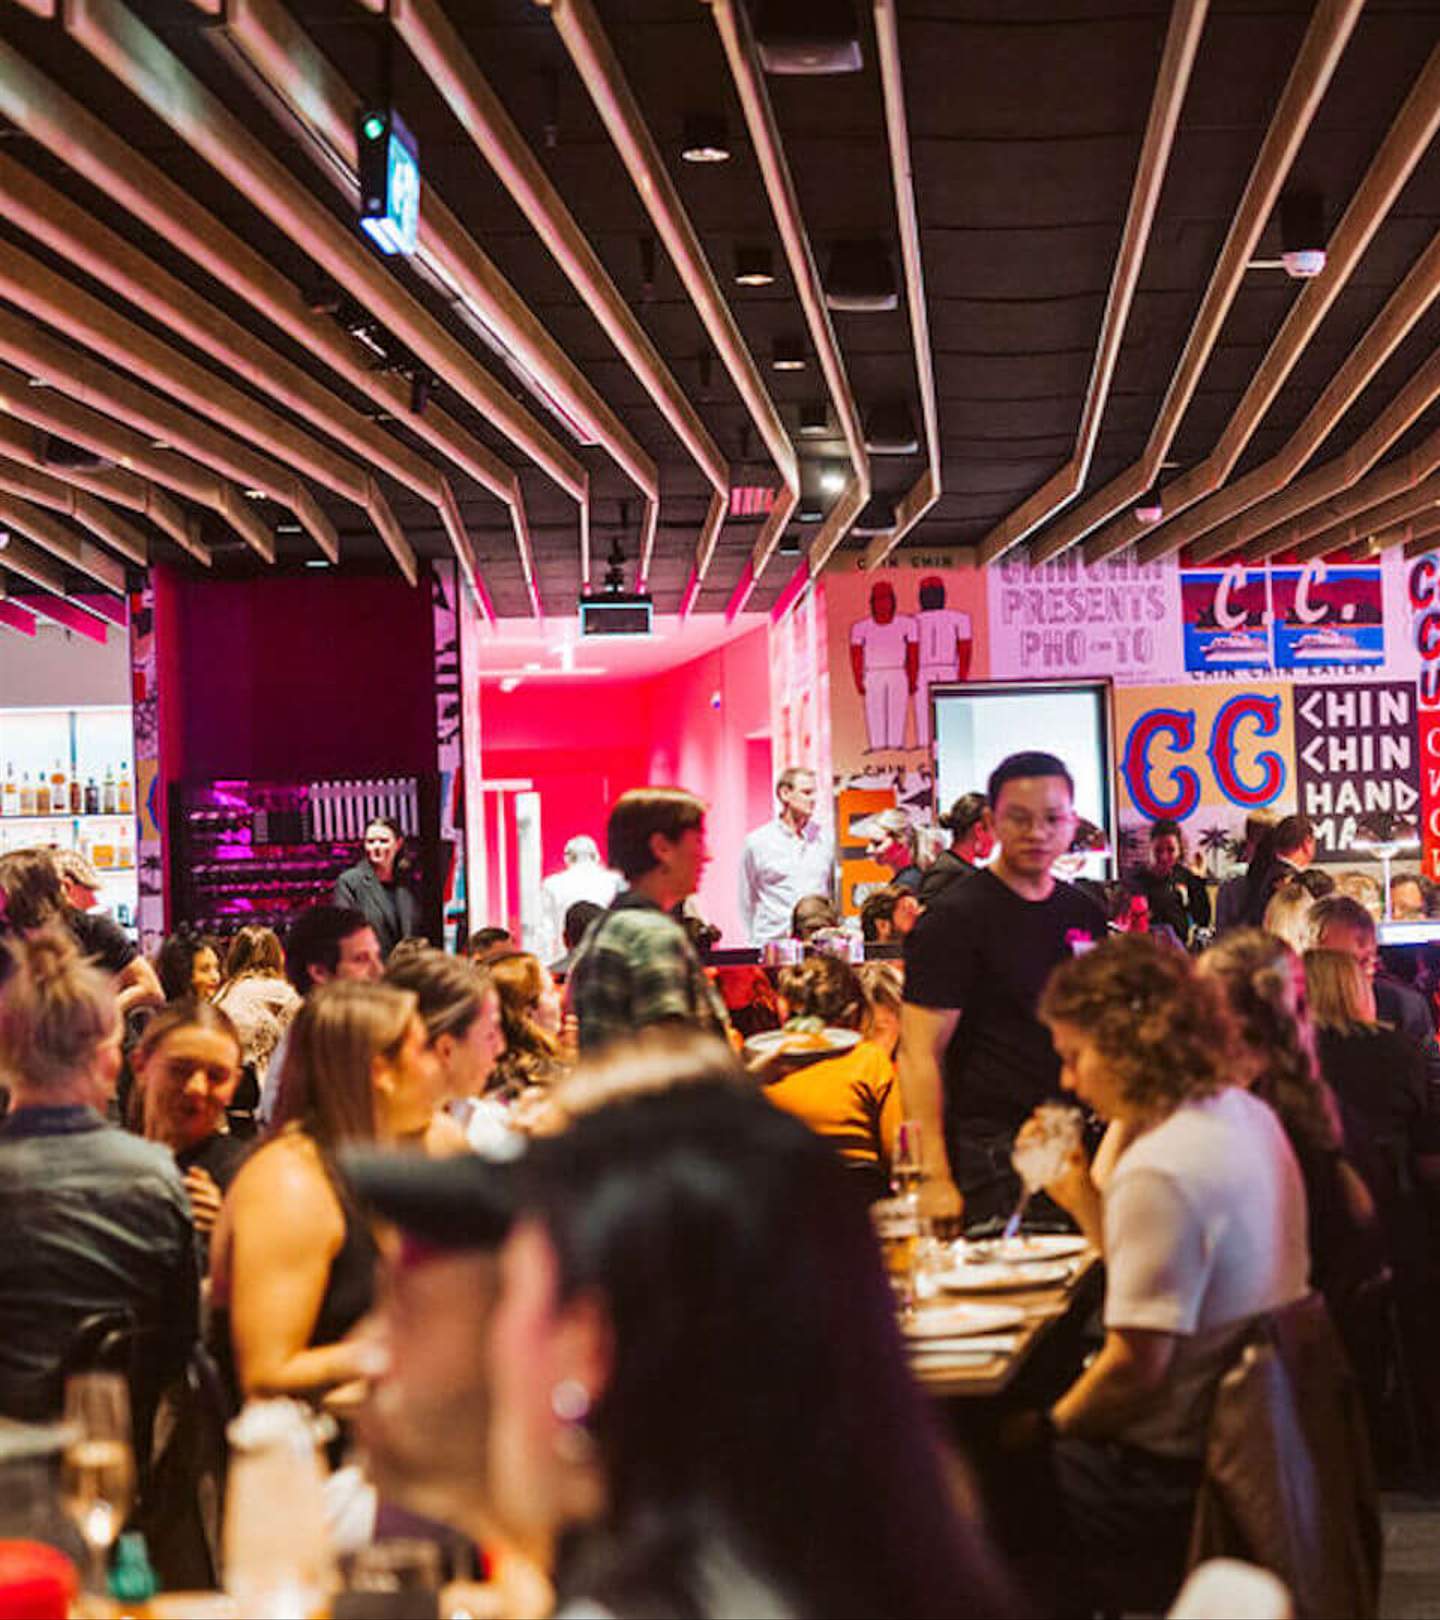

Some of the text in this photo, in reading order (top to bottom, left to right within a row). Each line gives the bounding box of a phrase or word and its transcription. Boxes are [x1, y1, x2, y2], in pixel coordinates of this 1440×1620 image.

[856, 556, 898, 570] CIN
[1001, 585, 1166, 625] PRESENTS
[1020, 627, 1154, 668] PHO-TO
[1191, 665, 1378, 680] CHIN CHIN EATERY
[1306, 778, 1419, 815] HAND
